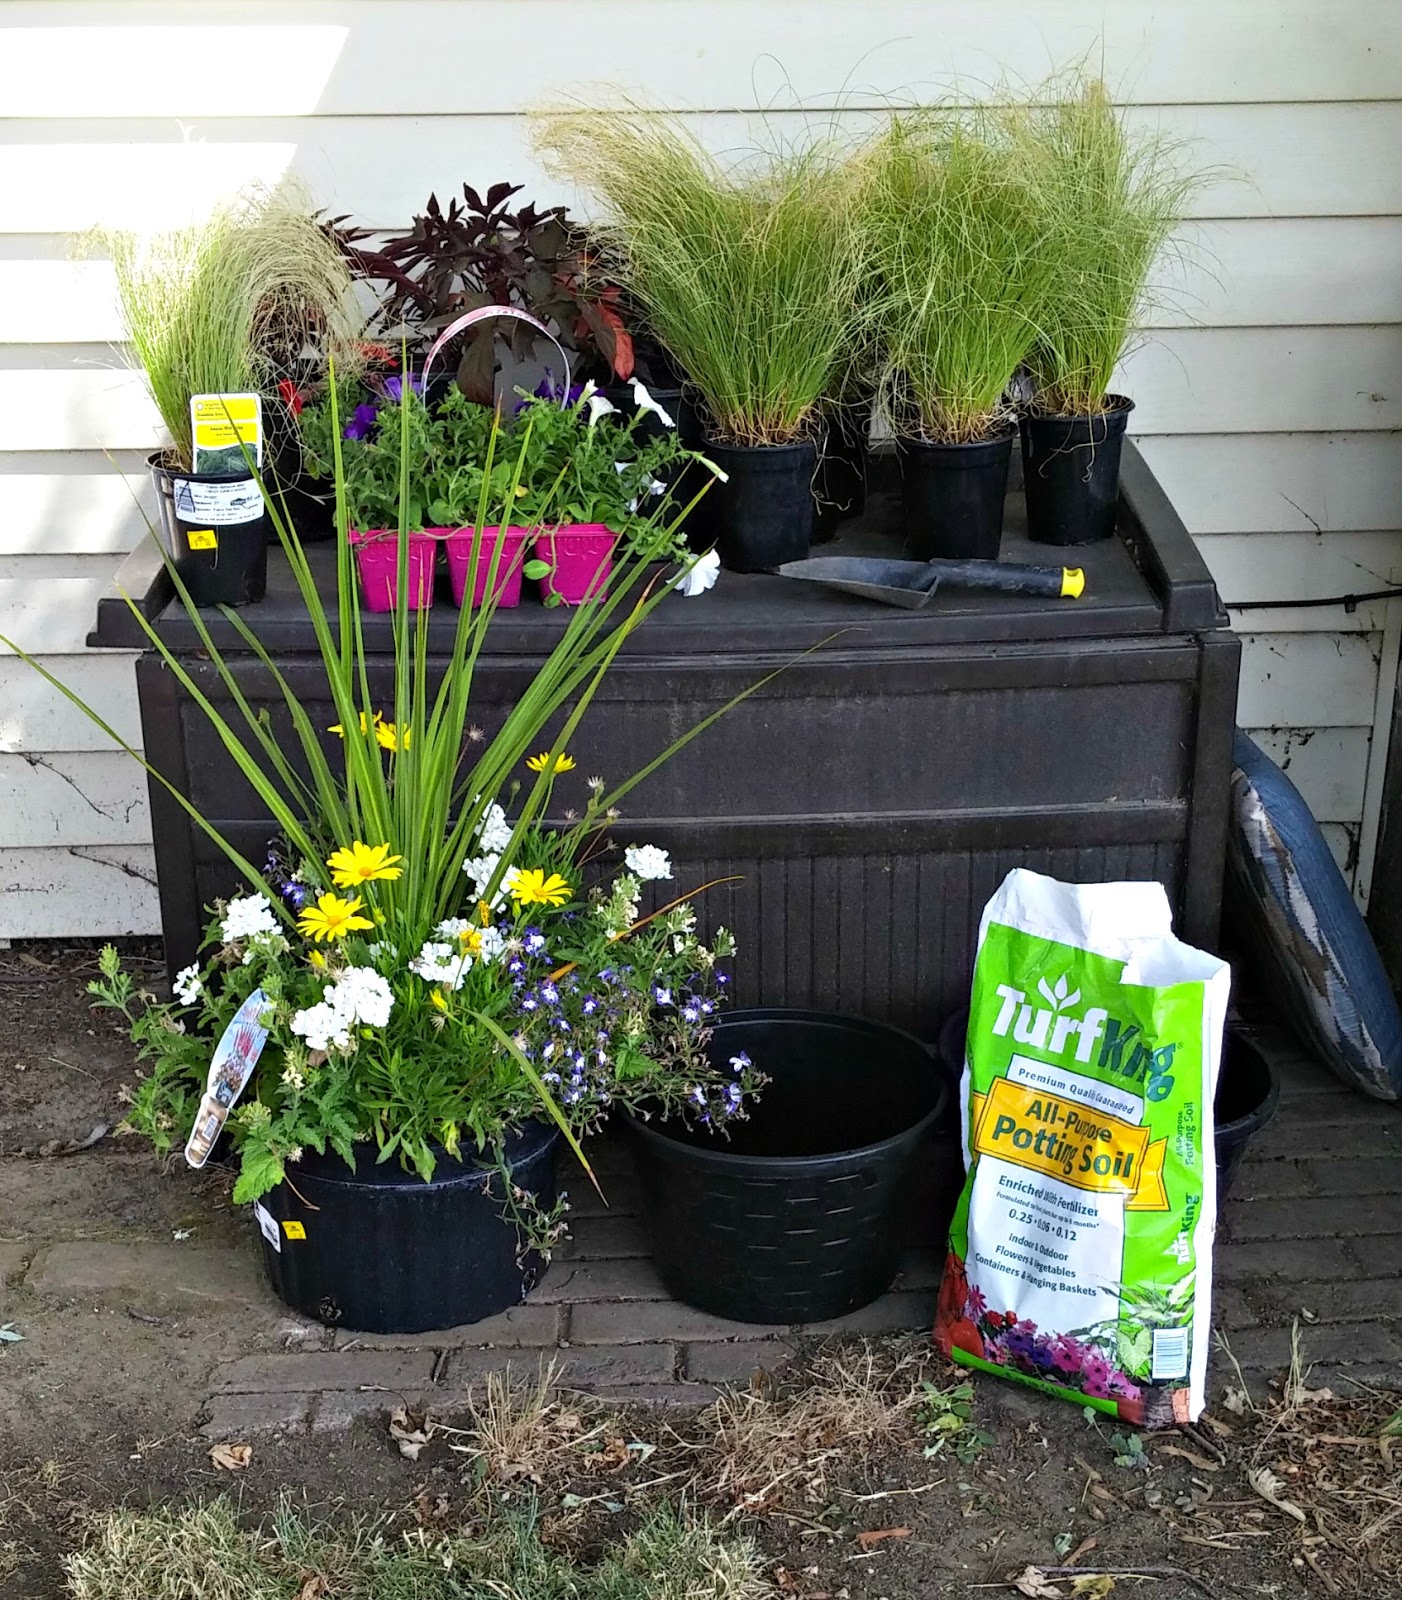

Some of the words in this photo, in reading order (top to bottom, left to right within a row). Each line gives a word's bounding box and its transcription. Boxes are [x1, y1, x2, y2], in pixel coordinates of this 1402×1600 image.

[1018, 1067, 1066, 1090] Premium
[1184, 1101, 1194, 1123] Soil
[991, 1114, 1079, 1175] Potting
[1078, 1145, 1135, 1178] Soil
[998, 1174, 1045, 1200] Enriched
[1056, 1196, 1099, 1217] Fertilizer
[1008, 1208, 1033, 1225] 0.25
[1056, 1226, 1077, 1241] 0.12
[995, 1245, 1030, 1265] Flowers
[1008, 1233, 1034, 1249] Indoor
[1039, 1244, 1069, 1262] Outdoor
[975, 1253, 1021, 1277] Containers
[1059, 1282, 1097, 1297] Baskets
